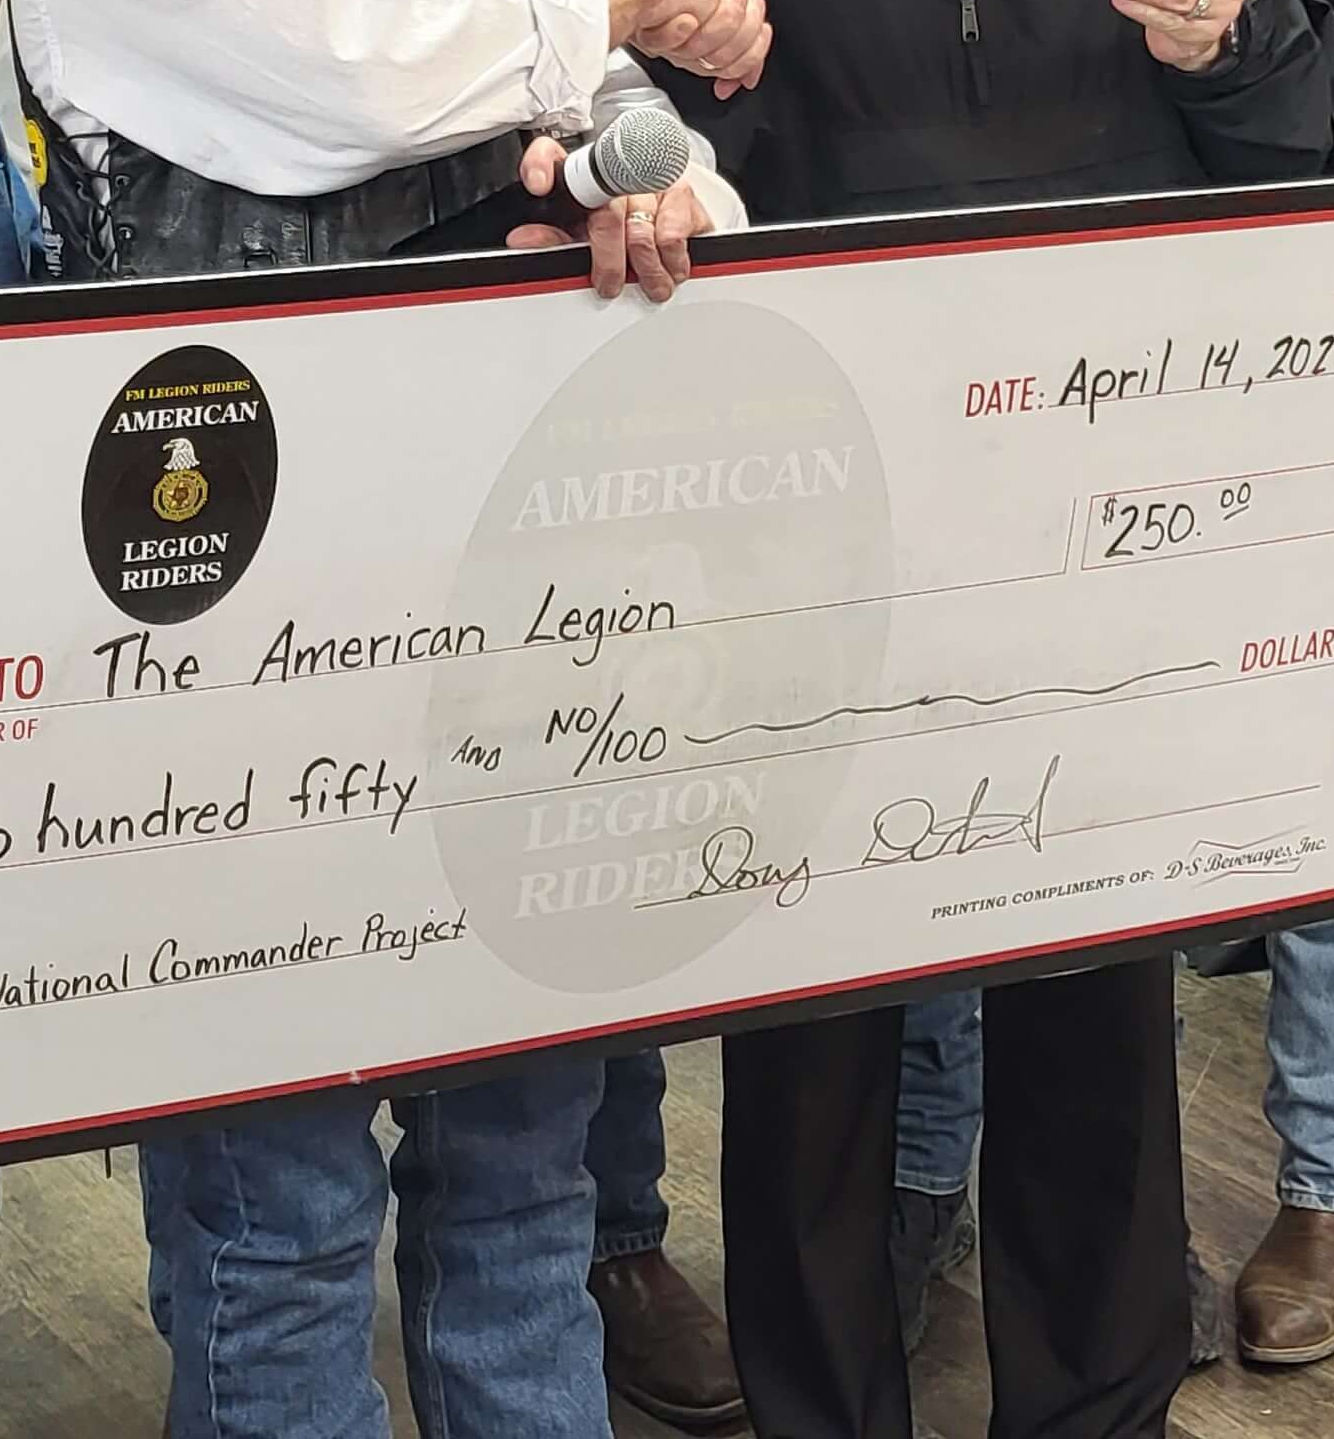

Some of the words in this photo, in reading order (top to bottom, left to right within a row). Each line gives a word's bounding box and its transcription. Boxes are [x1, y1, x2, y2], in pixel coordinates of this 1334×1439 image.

[126, 390, 145, 402] FM
[148, 384, 199, 400] LEGION
[202, 380, 251, 396] RIDERS
[966, 376, 1046, 418] DATE:
[1058, 338, 1173, 424] April
[1200, 339, 1254, 395] 14,
[111, 401, 260, 434] AMERICAN
[512, 445, 857, 532] AMERICAN
[123, 533, 229, 563] LEGION
[120, 562, 222, 592] RIDERS
[93, 631, 202, 699] The
[252, 612, 486, 687] American
[524, 584, 677, 667] Legion
[12, 718, 39, 742] OF
[37, 767, 254, 856] hundred
[289, 756, 418, 835] fifty
[523, 772, 767, 855] LEGION
[1294, 836, 1328, 861] Inc.
[931, 895, 1007, 920] PRINTING
[1011, 874, 1125, 906] COMPLIMENTS
[1129, 870, 1155, 885] OF:
[148, 920, 343, 986] Commander
[363, 906, 466, 960] Project
